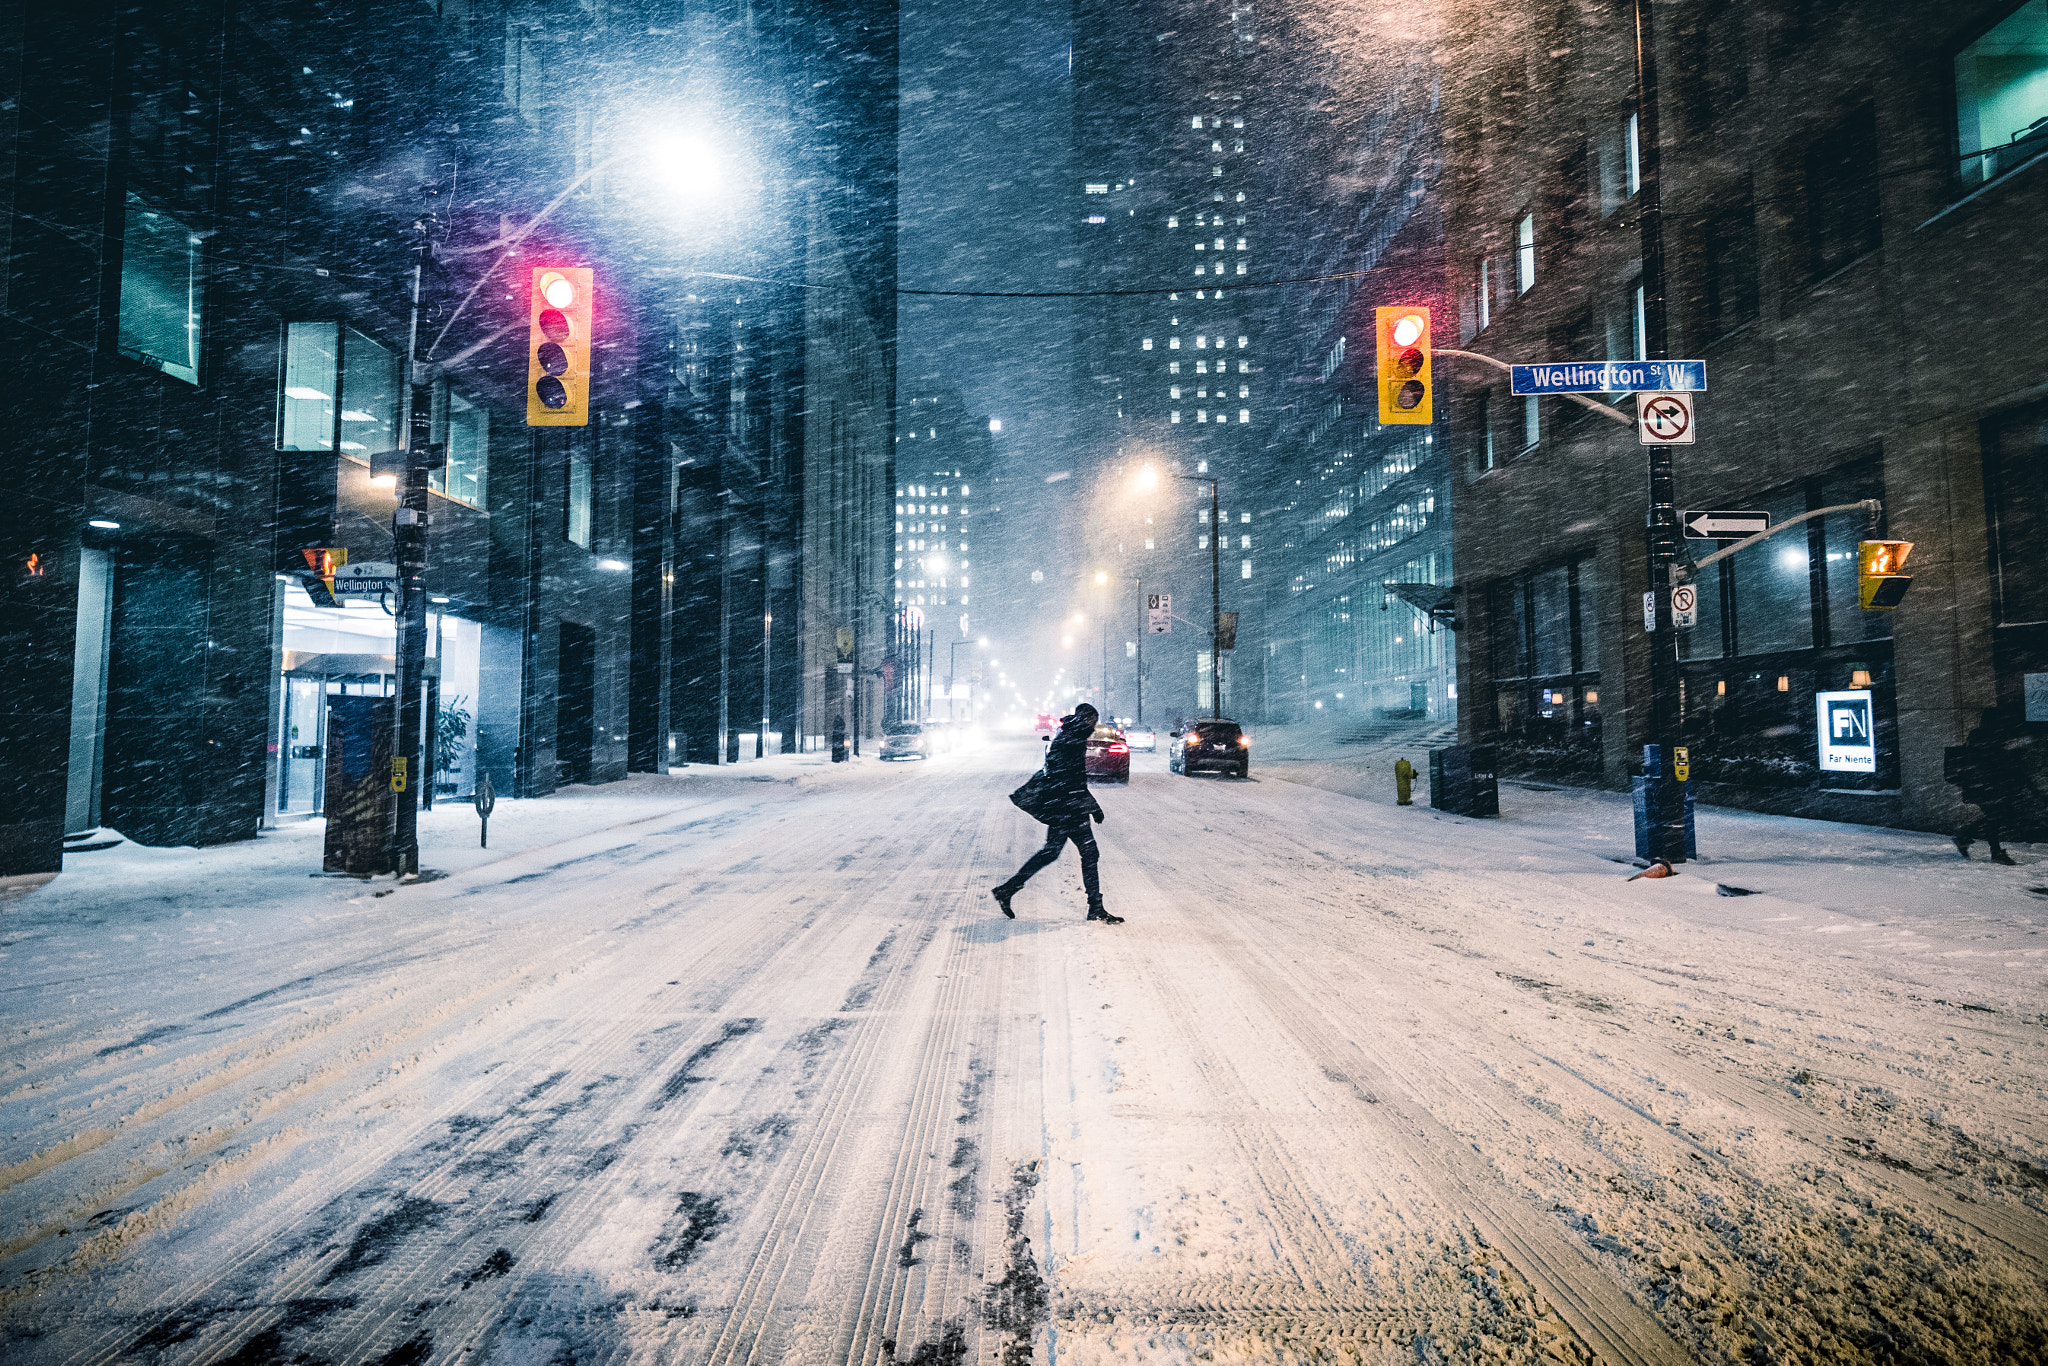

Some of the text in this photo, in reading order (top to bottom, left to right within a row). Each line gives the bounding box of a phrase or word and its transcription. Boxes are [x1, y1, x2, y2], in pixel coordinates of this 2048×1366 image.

[1532, 364, 1685, 389] Wellington St W
[335, 579, 383, 593] Wellington
[1832, 708, 1867, 738] FN
[1829, 754, 1872, 764] Far Niente
